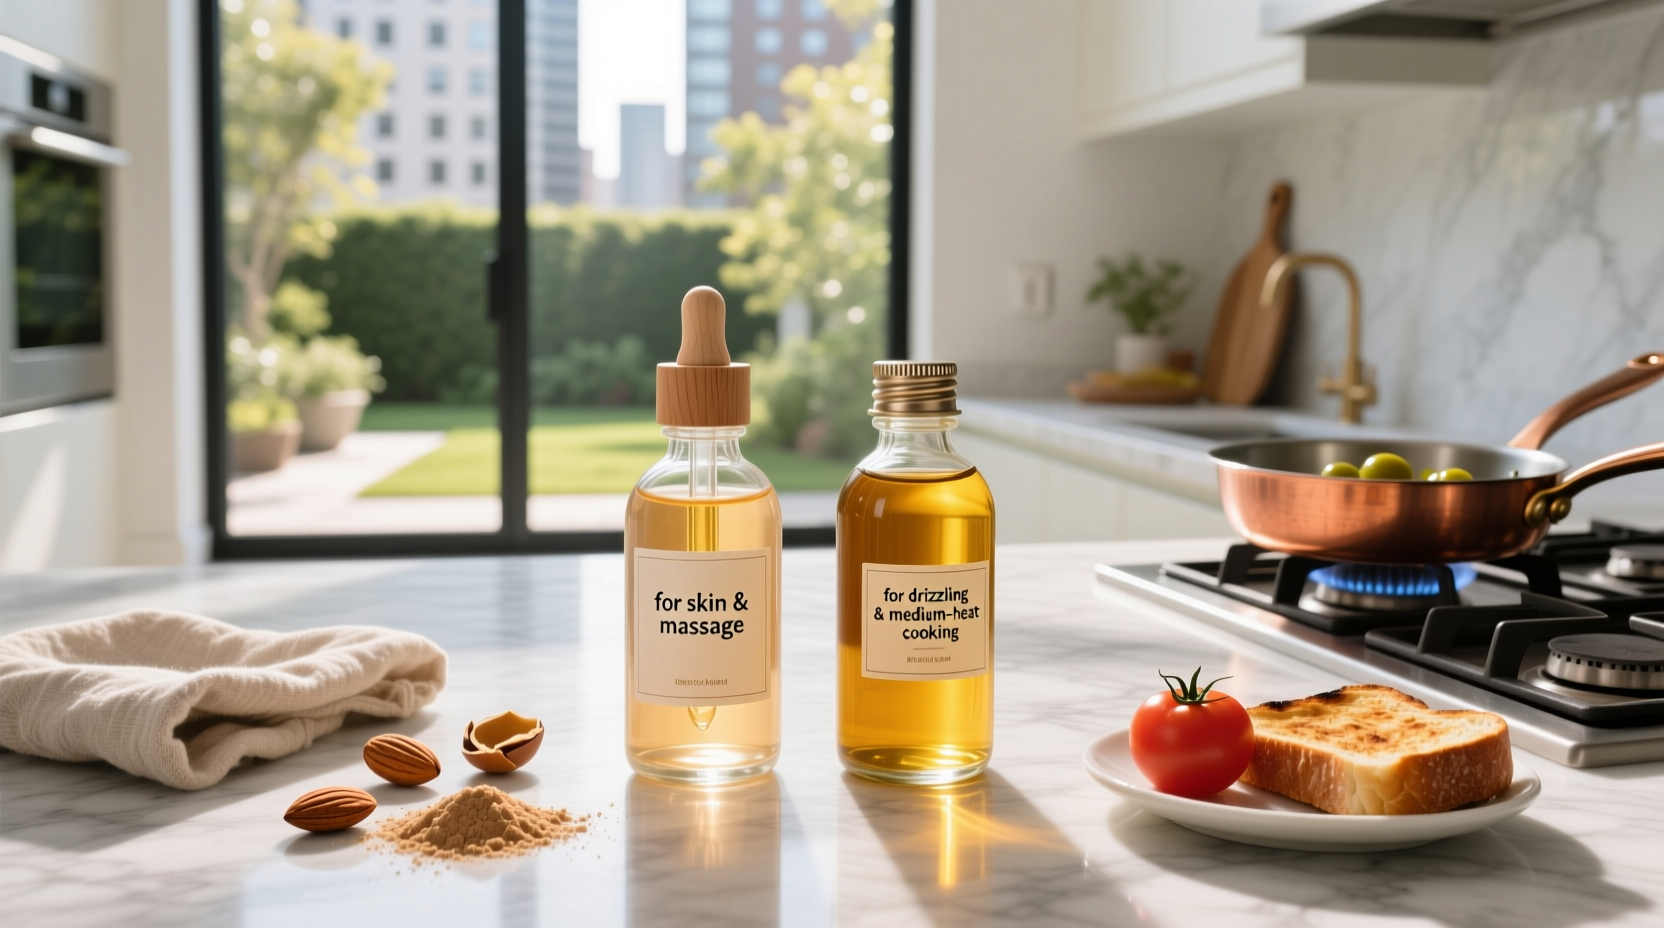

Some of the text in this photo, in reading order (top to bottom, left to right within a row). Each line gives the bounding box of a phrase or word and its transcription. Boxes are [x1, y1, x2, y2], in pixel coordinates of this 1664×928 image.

[654, 591, 749, 612] for skin &
[883, 586, 969, 604] for drizzling
[873, 605, 980, 621] & medium-heat
[660, 619, 745, 640] massage
[902, 624, 960, 642] cooking
